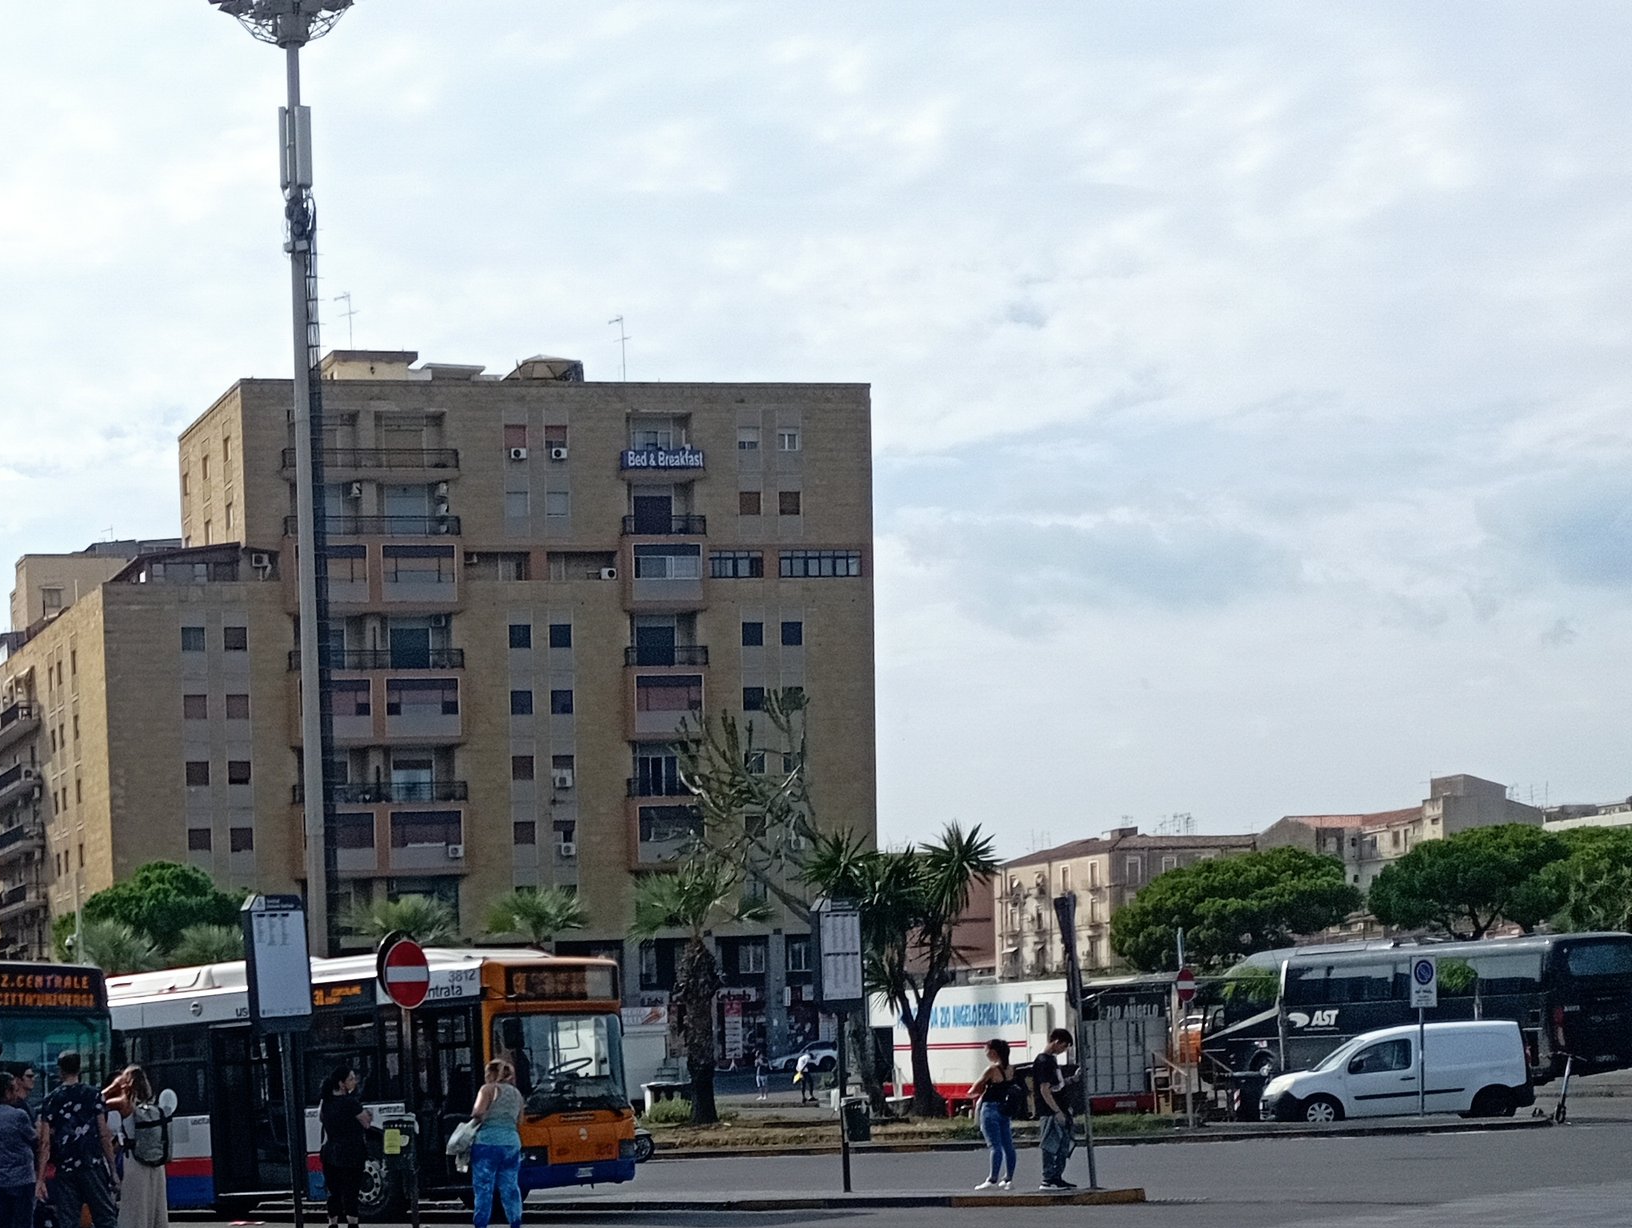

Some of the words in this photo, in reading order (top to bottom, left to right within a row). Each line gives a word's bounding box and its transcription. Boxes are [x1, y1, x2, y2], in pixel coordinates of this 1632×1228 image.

[628, 451, 647, 467] Bed
[649, 453, 657, 466] &
[658, 451, 704, 467] Breakfast
[448, 968, 477, 983] 3812
[428, 985, 463, 998] ntrata
[1106, 1005, 1121, 1019] ZIO
[1123, 1003, 1159, 1019] ANGELO
[1311, 1009, 1339, 1026] AST
